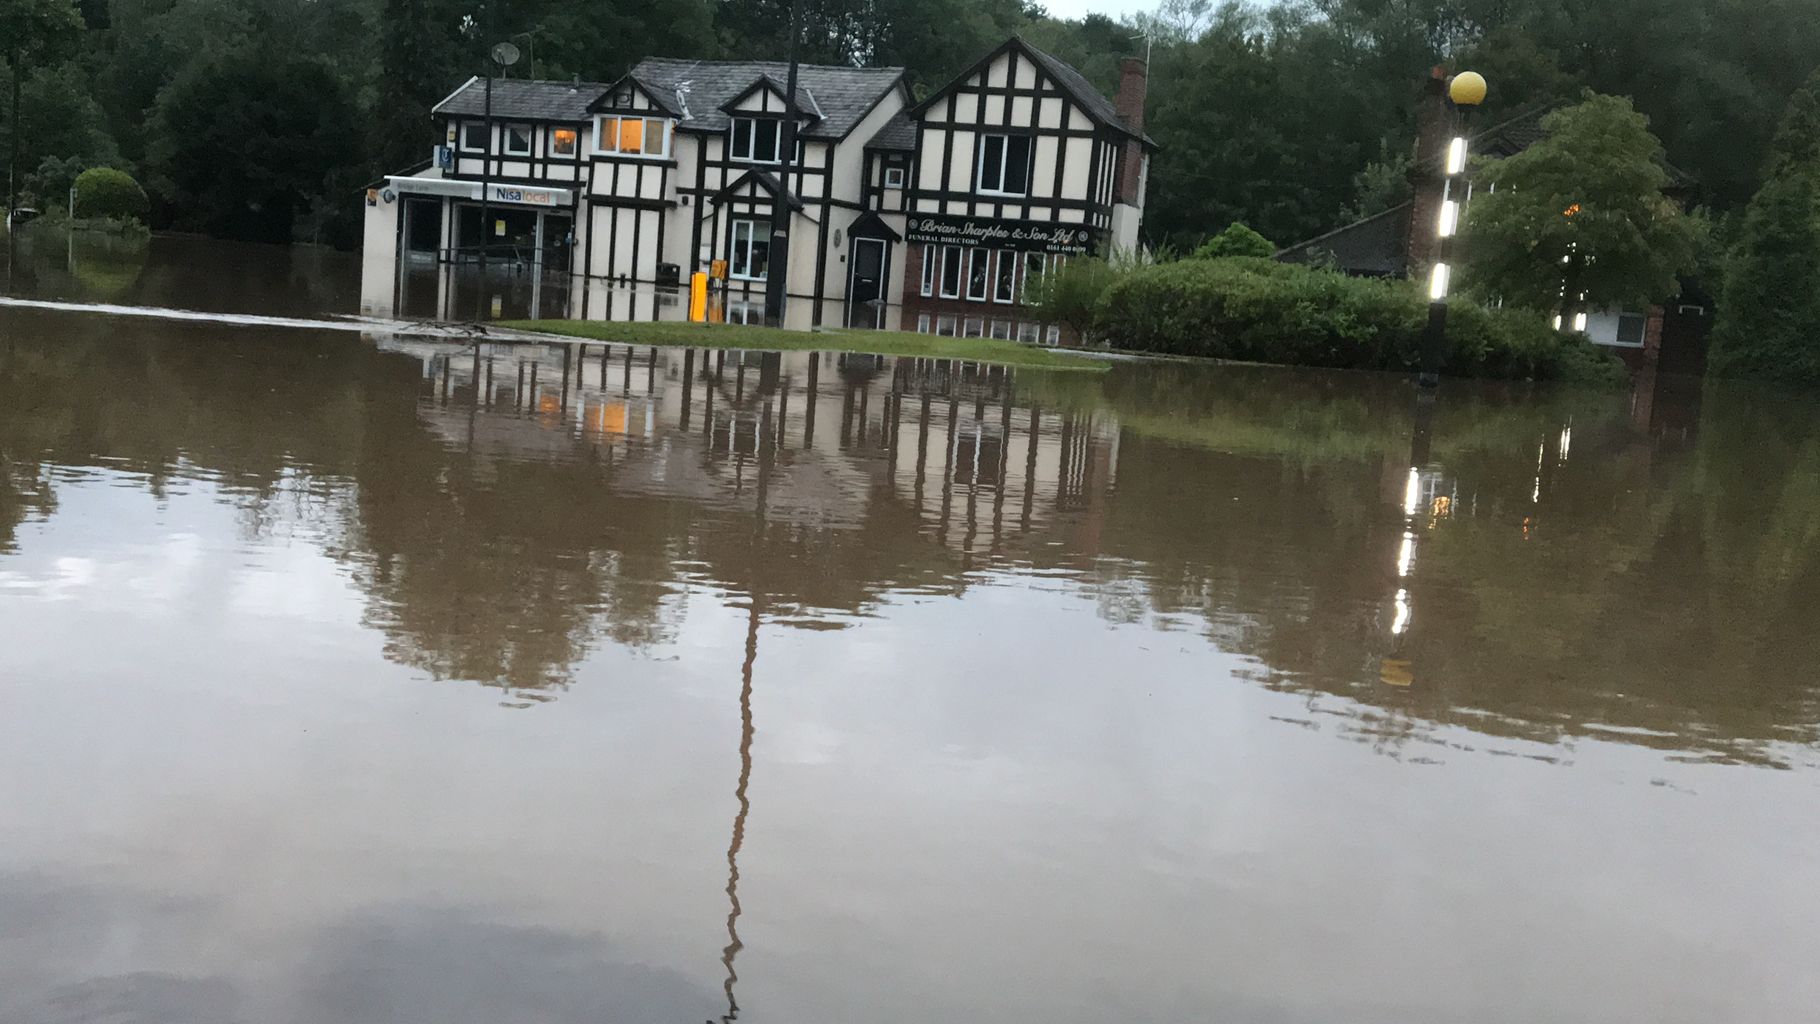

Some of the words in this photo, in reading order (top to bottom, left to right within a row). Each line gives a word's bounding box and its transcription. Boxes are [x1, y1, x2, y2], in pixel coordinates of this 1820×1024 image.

[920, 219, 957, 234] Brian
[957, 222, 1010, 241] Sharples
[1012, 228, 1024, 239] &
[1025, 227, 1049, 240] Son
[1048, 228, 1075, 241] Ltd
[908, 233, 939, 242] FUNERAL
[940, 236, 979, 245] DIRECTORS
